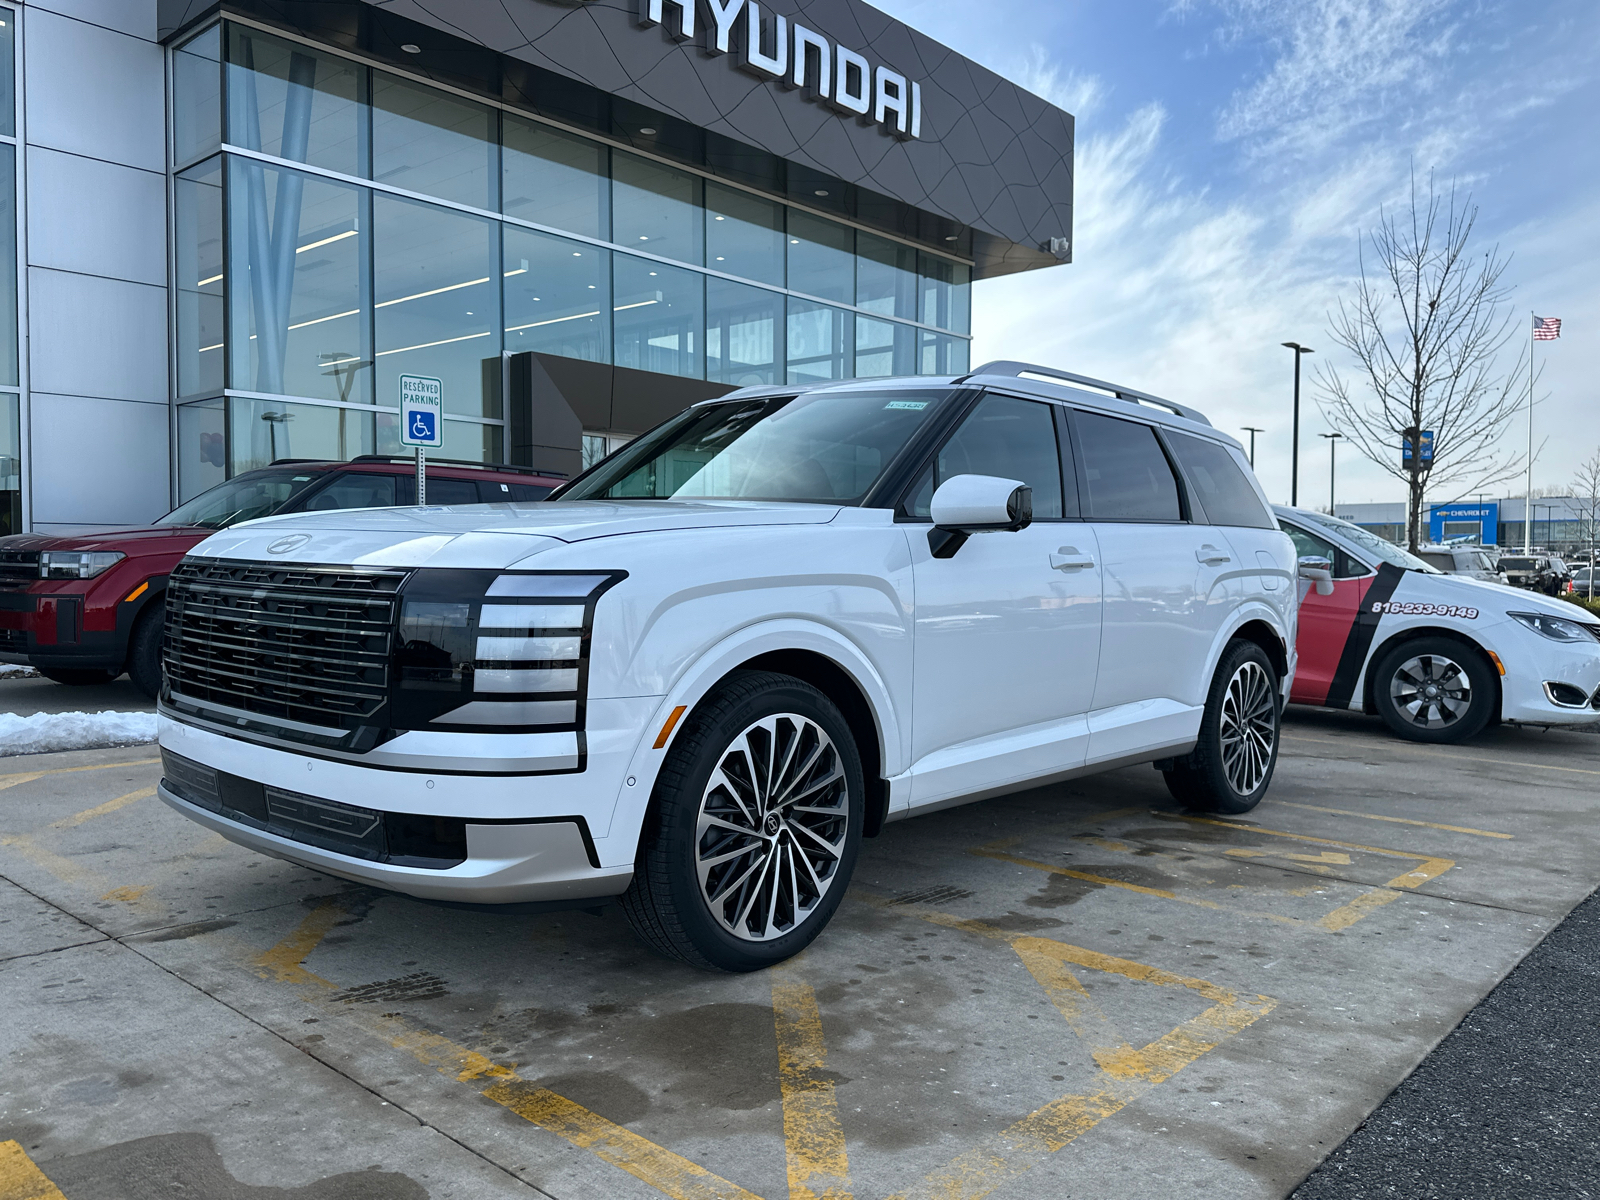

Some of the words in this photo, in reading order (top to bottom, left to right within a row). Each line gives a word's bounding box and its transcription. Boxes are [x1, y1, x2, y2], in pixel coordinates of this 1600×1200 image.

[404, 381, 438, 394] RESERVED
[404, 393, 439, 406] PARKING
[1371, 601, 1480, 619] 816-233-9149
[719, 701, 754, 736] PIRELLI
